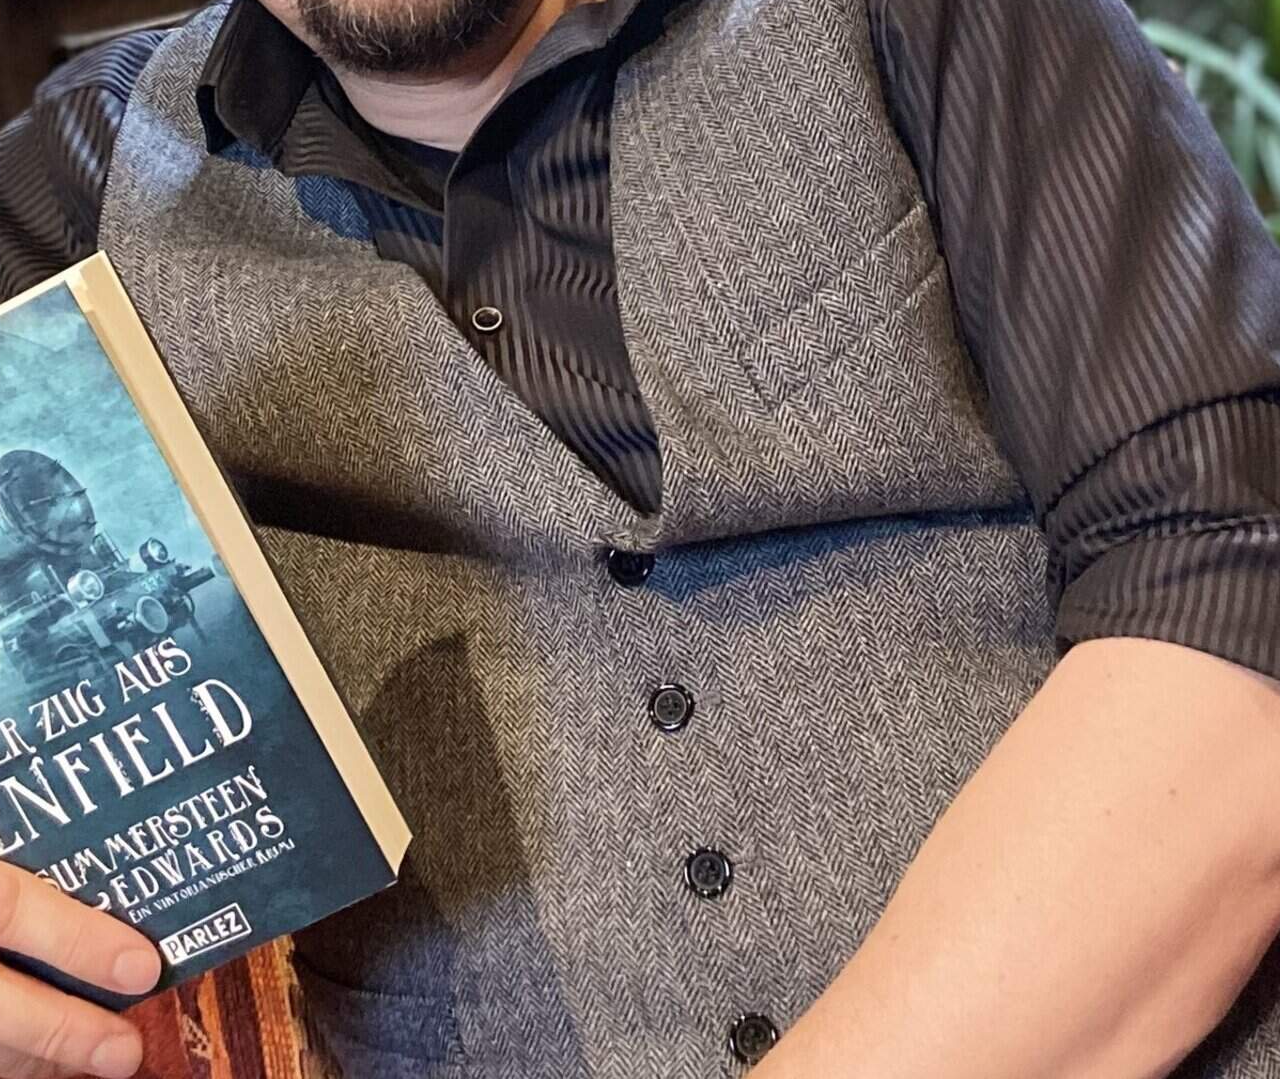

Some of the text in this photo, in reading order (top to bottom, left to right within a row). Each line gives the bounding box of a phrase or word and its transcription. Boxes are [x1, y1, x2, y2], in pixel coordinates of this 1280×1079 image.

[28, 678, 106, 742] ZUG
[114, 636, 192, 704] AUS
[110, 805, 285, 909] EDWARDS
[166, 911, 243, 960] PARLEZ
